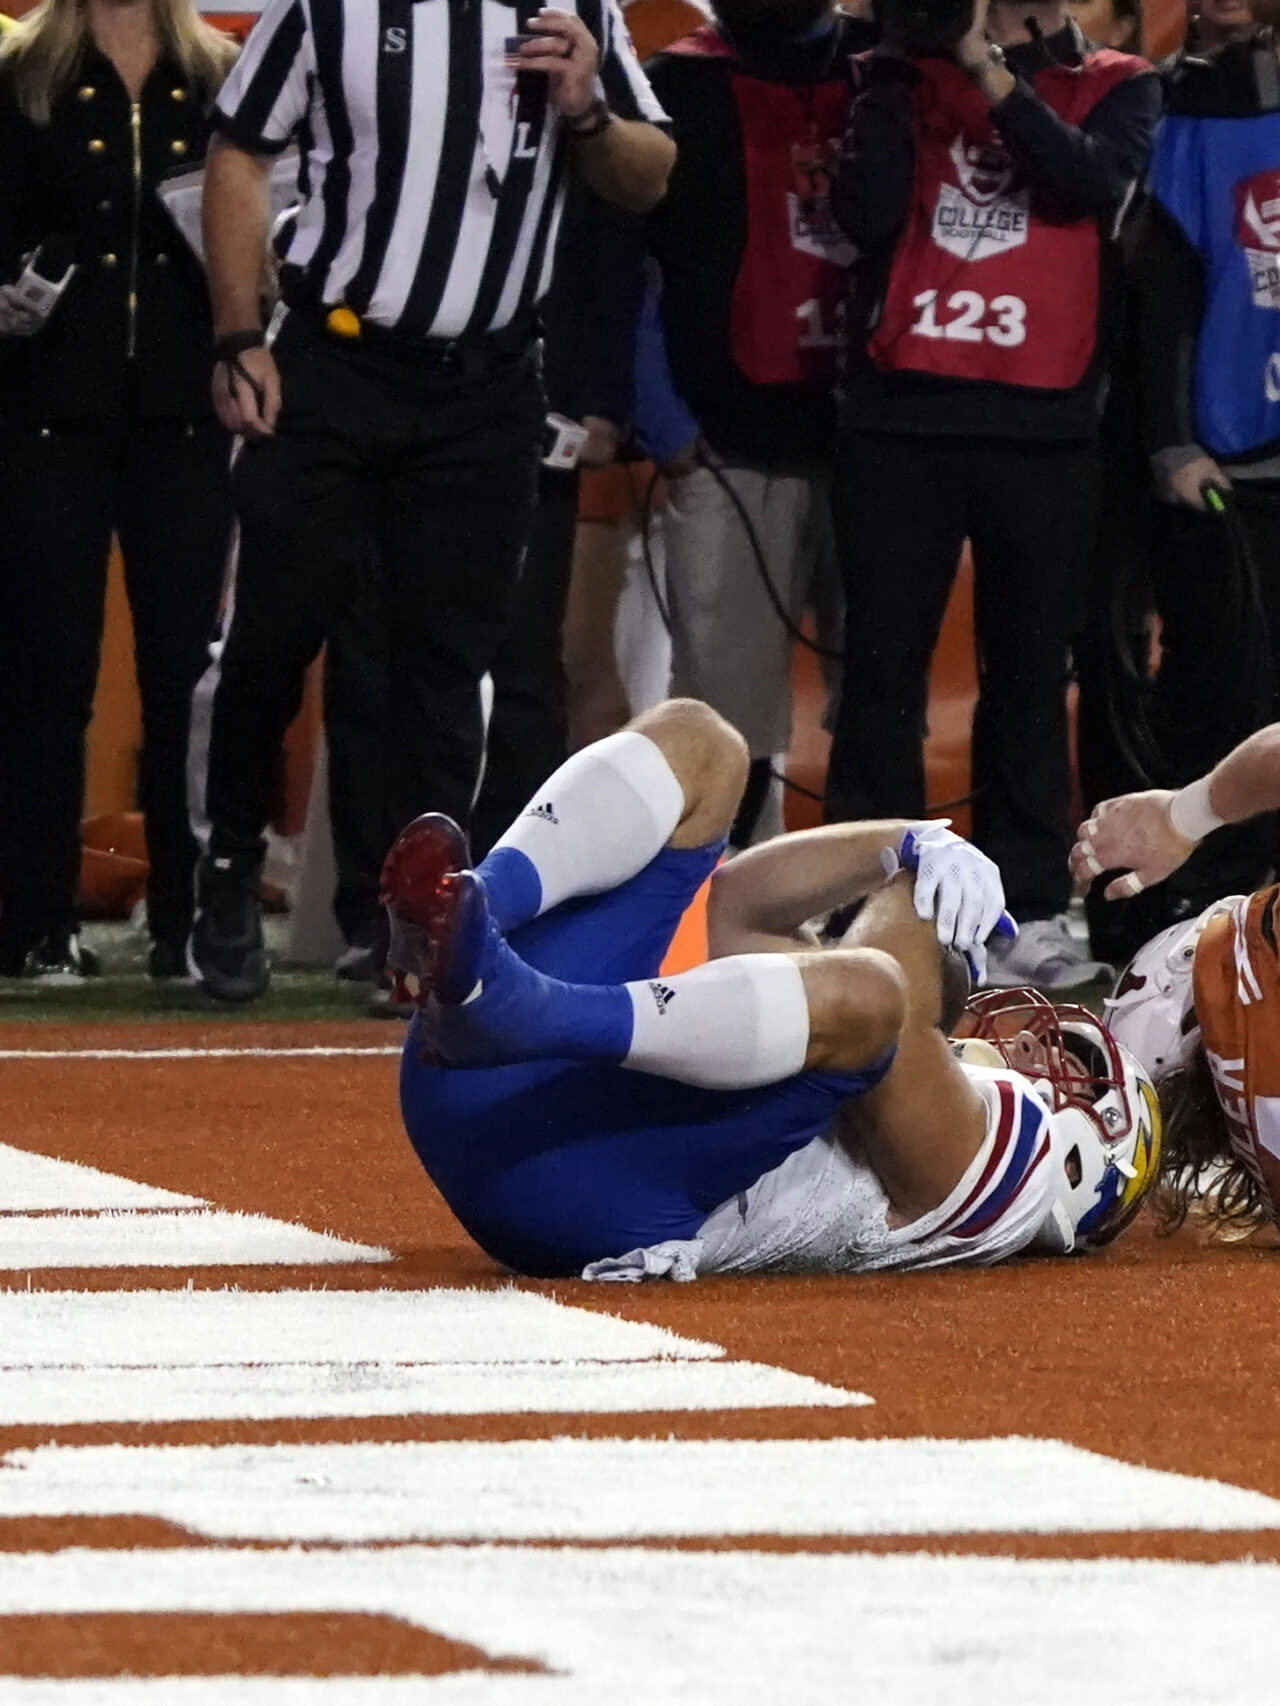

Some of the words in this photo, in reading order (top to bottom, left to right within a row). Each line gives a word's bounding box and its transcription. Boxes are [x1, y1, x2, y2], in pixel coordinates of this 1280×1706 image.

[384, 26, 406, 53] S
[514, 121, 537, 158] L
[911, 289, 1027, 347] 123
